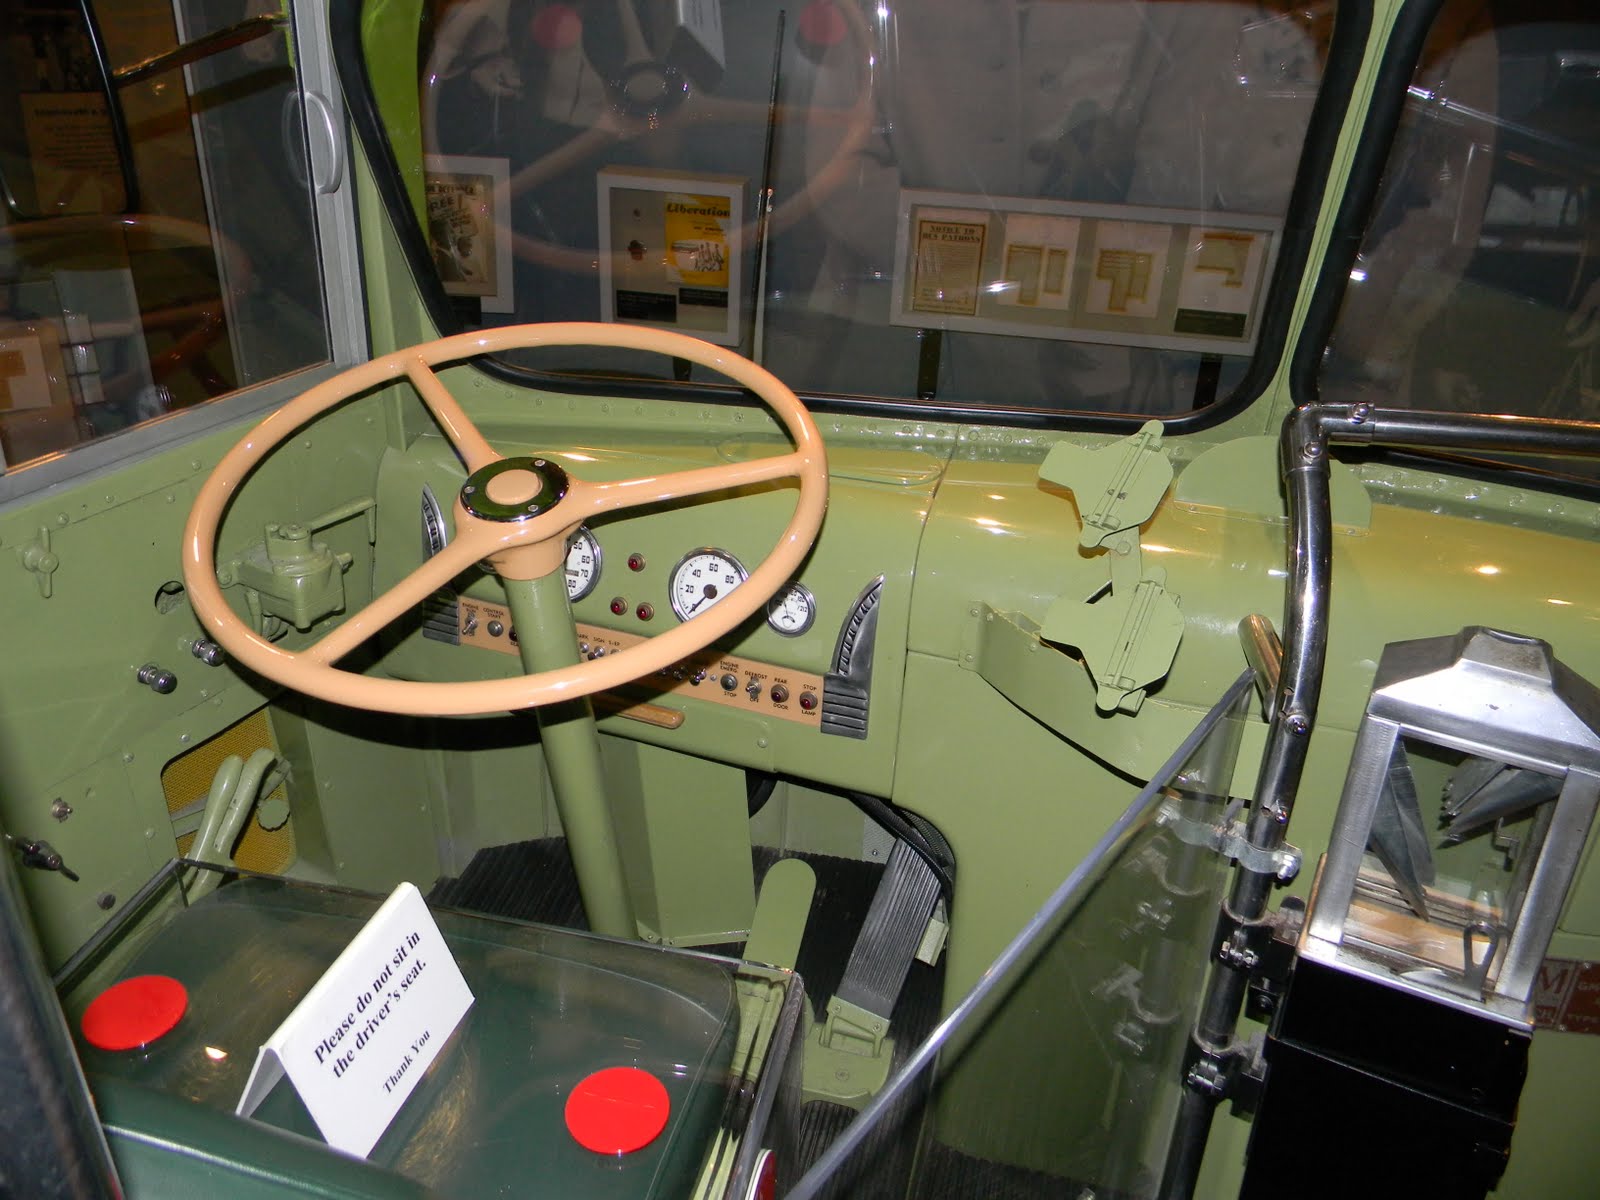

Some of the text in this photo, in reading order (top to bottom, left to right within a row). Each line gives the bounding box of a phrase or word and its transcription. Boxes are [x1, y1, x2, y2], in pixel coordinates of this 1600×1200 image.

[667, 203, 730, 217] Liberation
[930, 225, 960, 234] NOTICE
[941, 234, 981, 243] PATRONS
[581, 555, 591, 564] 60
[709, 563, 719, 572] 60
[581, 568, 589, 578] 70
[692, 569, 701, 578] 40
[725, 575, 735, 584] 80
[685, 584, 694, 594] 20
[720, 660, 739, 669] ENGINE
[744, 670, 768, 680] DEFROST
[803, 683, 817, 691] STOP
[773, 703, 789, 711] DOOR
[801, 709, 817, 717] LAMP
[313, 931, 421, 1065] Please do not sit in
[332, 961, 427, 1079] the driver's seat.
[382, 1029, 431, 1095] Thank You
